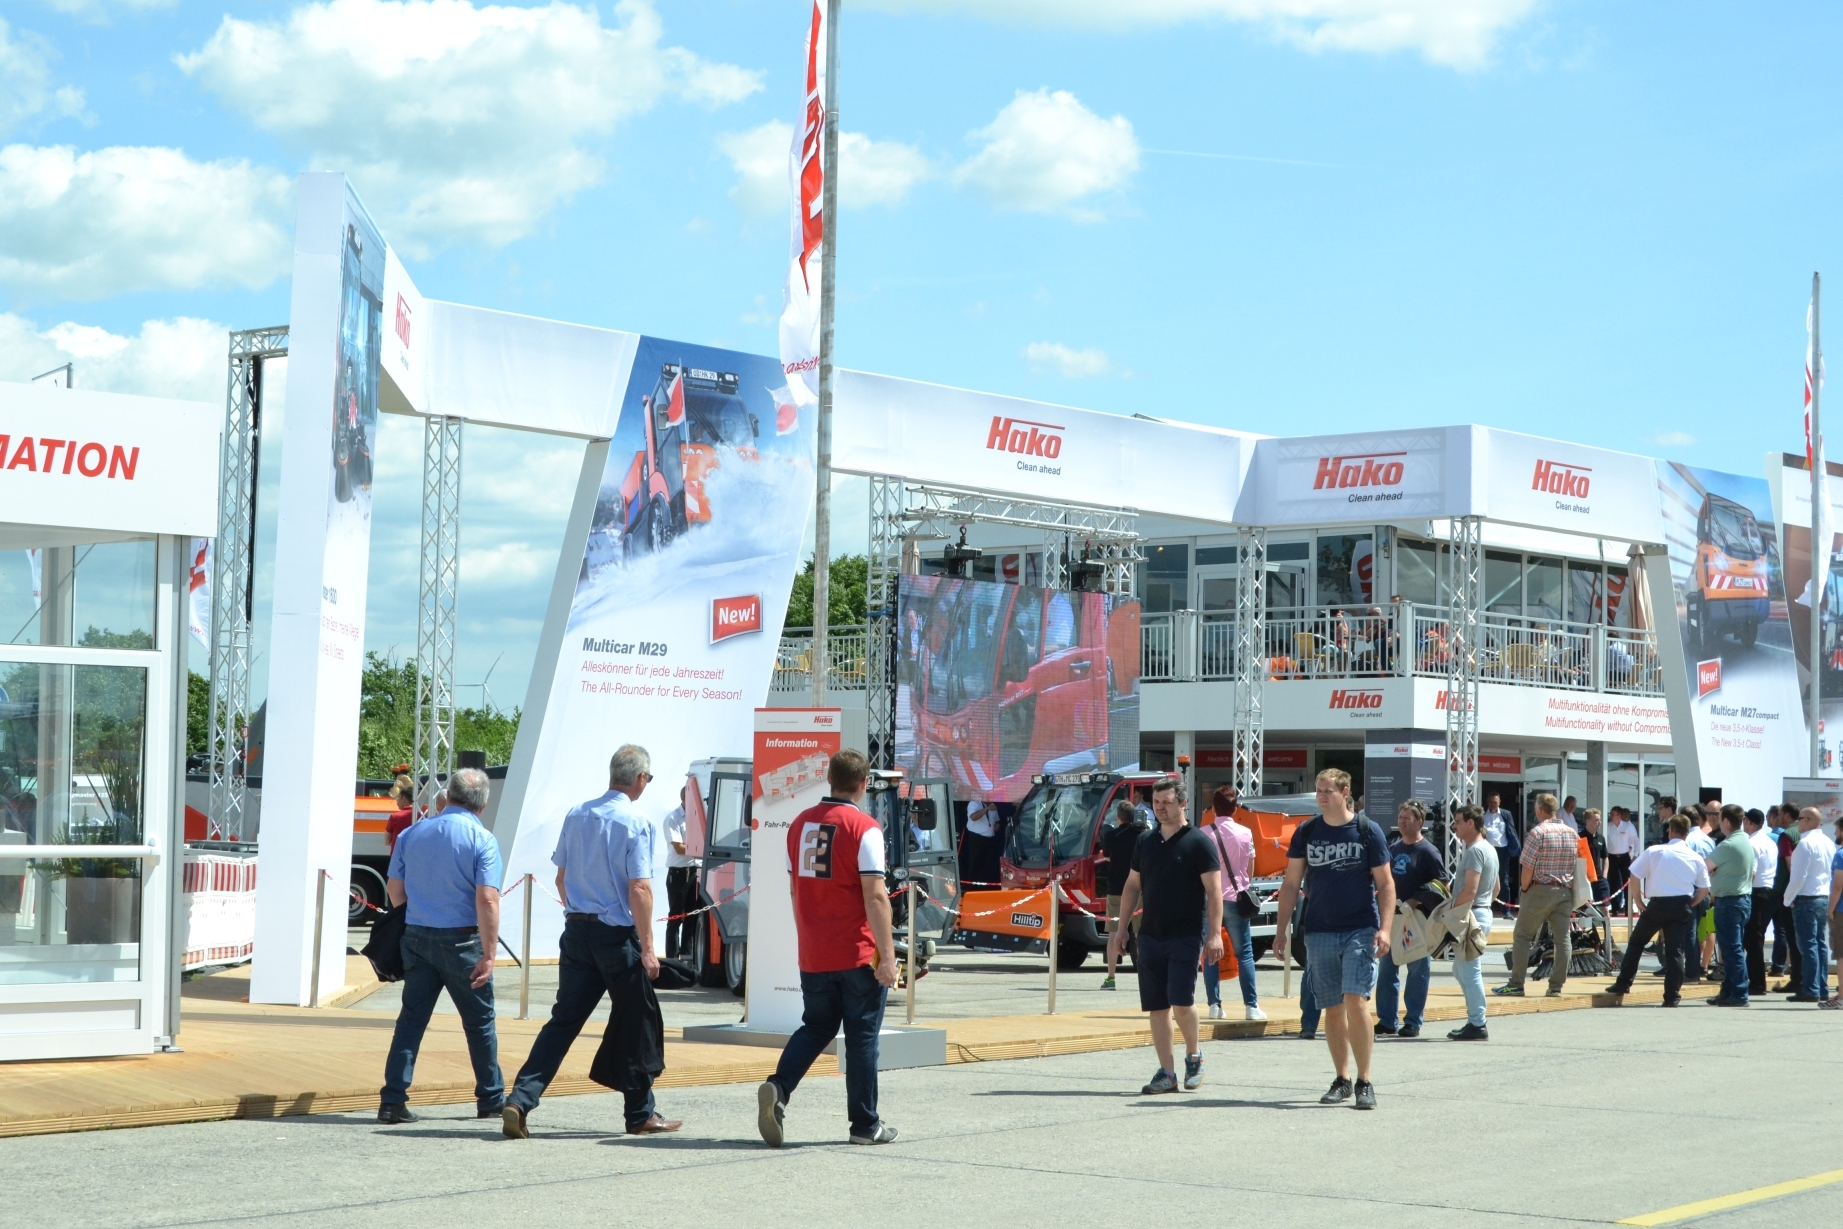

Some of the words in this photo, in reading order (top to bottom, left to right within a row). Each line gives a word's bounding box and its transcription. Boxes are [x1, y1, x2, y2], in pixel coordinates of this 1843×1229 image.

[986, 415, 1066, 459] Hako
[0, 434, 140, 481] ATION
[1017, 460, 1038, 473] Clean
[1039, 464, 1061, 476] ahead
[1312, 451, 1408, 490] Hako
[1531, 458, 1593, 499] Hako
[1348, 493, 1373, 503] Clean
[1375, 491, 1403, 502] ahead
[1555, 500, 1572, 512] Clean
[1573, 504, 1591, 514] ahead
[718, 603, 756, 625] New!
[582, 637, 635, 655] Multicar
[638, 641, 668, 657] M29
[581, 660, 634, 675] Alleskönner
[635, 663, 648, 676] für
[649, 665, 670, 679] jede
[672, 666, 725, 680] Jahreszeit!
[1700, 668, 1718, 685] New!
[581, 680, 597, 693] The
[599, 682, 655, 697] All-Rounder
[657, 685, 671, 697] for
[672, 686, 700, 701] Every
[702, 687, 743, 701] Season!
[1329, 688, 1385, 709] Hako
[1548, 697, 1611, 715] Multifunktionalität
[1612, 704, 1630, 716] ohne
[1710, 704, 1739, 717] Multicar
[813, 716, 833, 724] Hako
[1545, 715, 1605, 733] Multifunctionality
[1607, 721, 1633, 732] without
[1710, 721, 1718, 732] Die
[1719, 723, 1732, 732] neue
[765, 738, 818, 748] Information
[1711, 736, 1721, 747] The
[1721, 738, 1732, 748] New
[1307, 841, 1364, 864] ESPRIT
[1013, 913, 1041, 927] Hilltip
